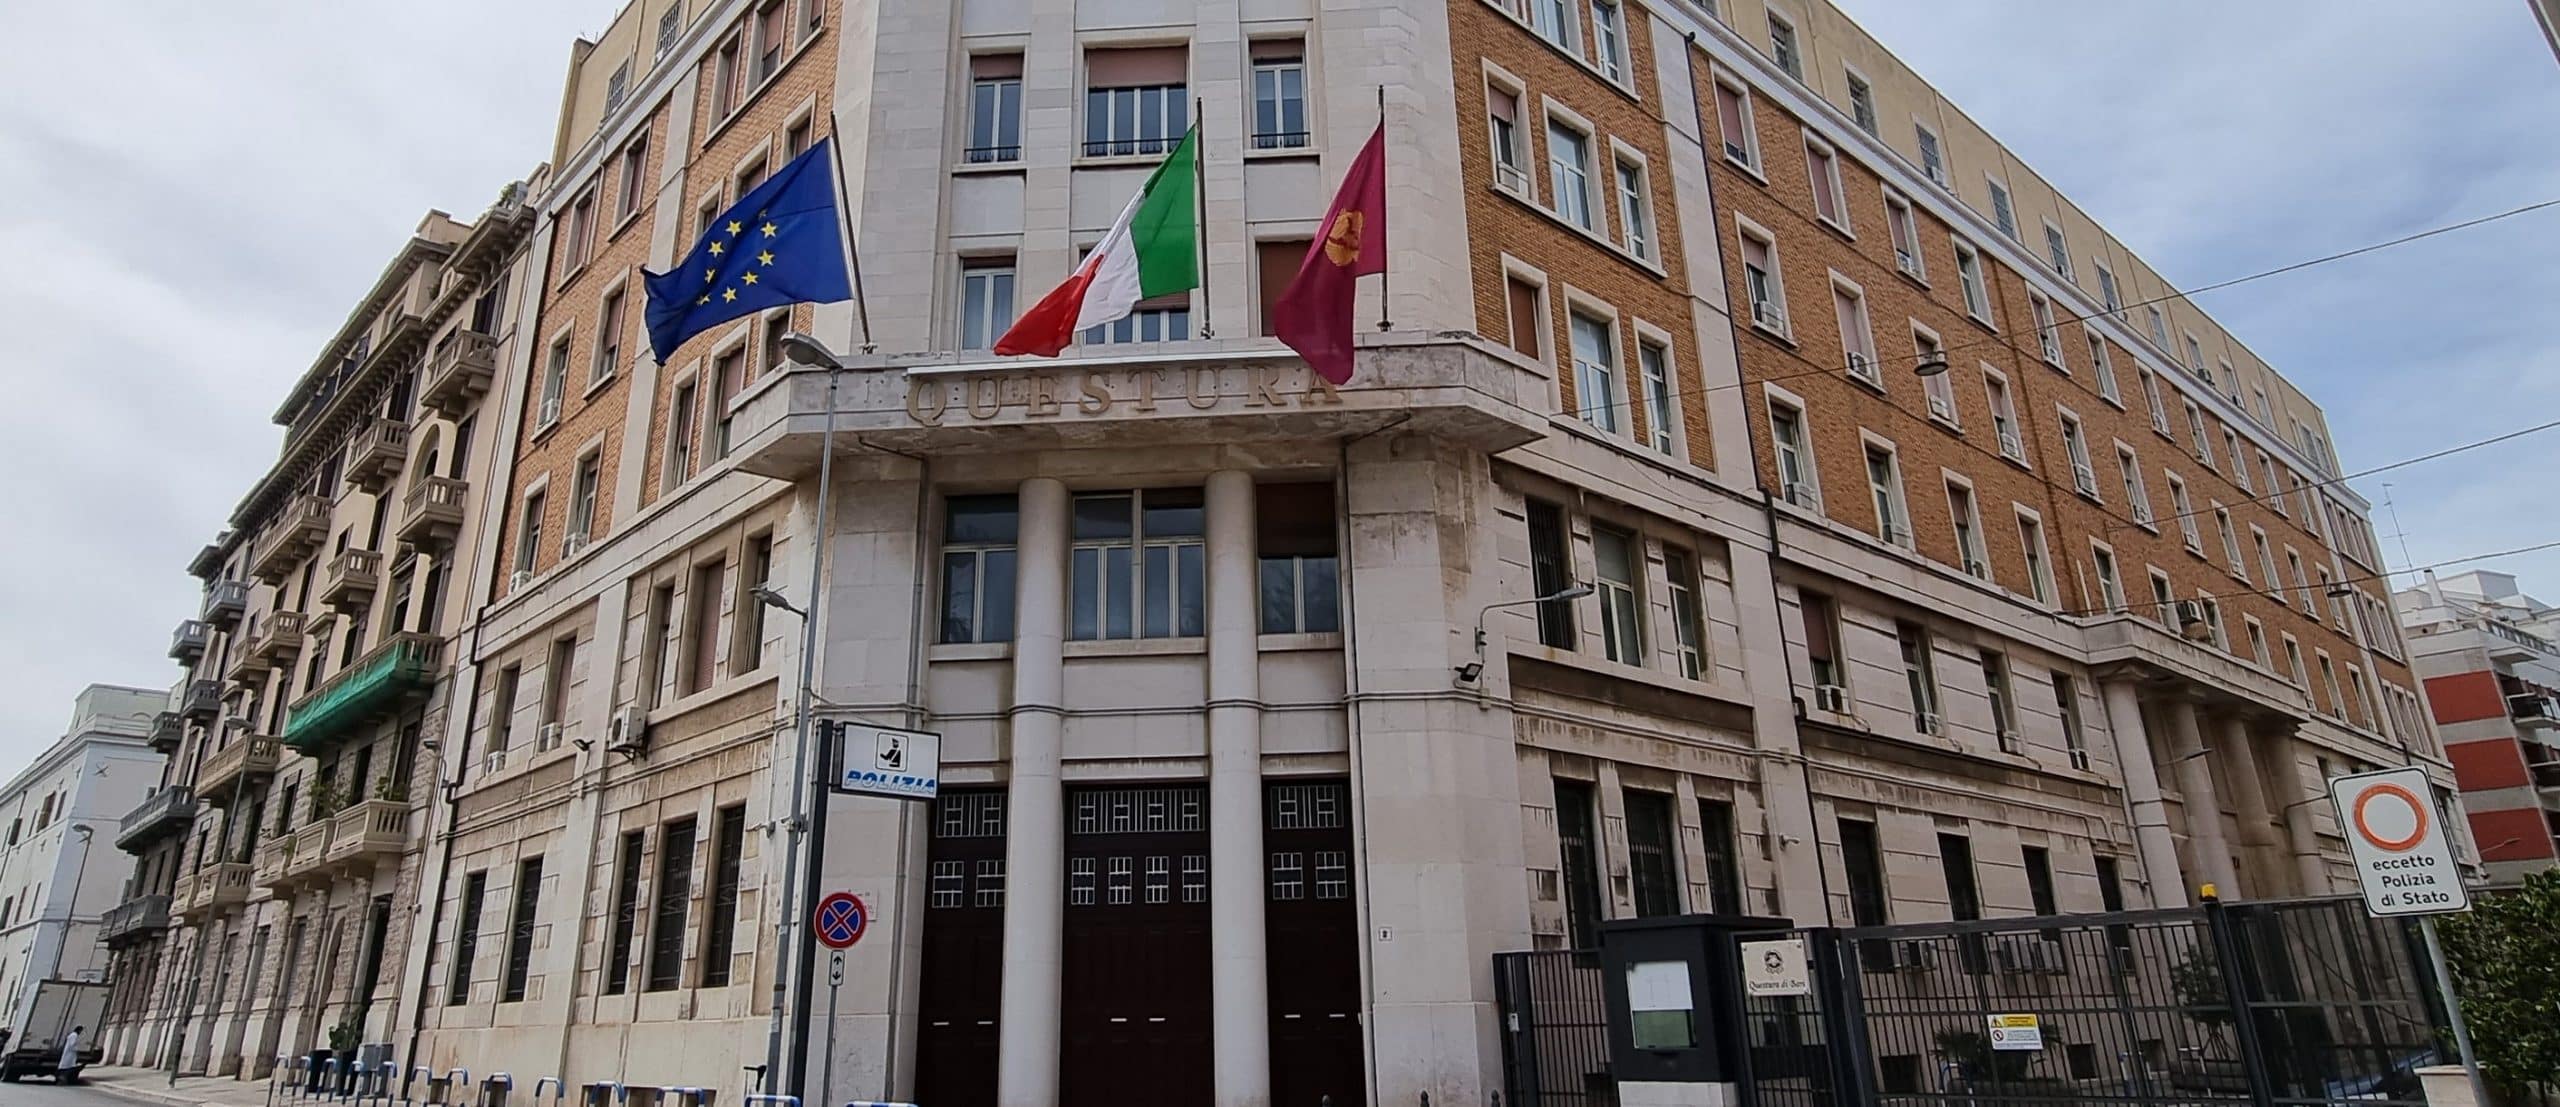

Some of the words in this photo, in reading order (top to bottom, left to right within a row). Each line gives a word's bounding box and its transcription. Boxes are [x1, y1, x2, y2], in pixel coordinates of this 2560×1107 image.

[907, 366, 1343, 427] QUESTURA
[846, 770, 936, 793] POLIZIA
[2373, 855, 2435, 870] eccetto
[2382, 873, 2435, 888] Polizia
[2381, 894, 2395, 906] di
[2402, 891, 2449, 905] Stato
